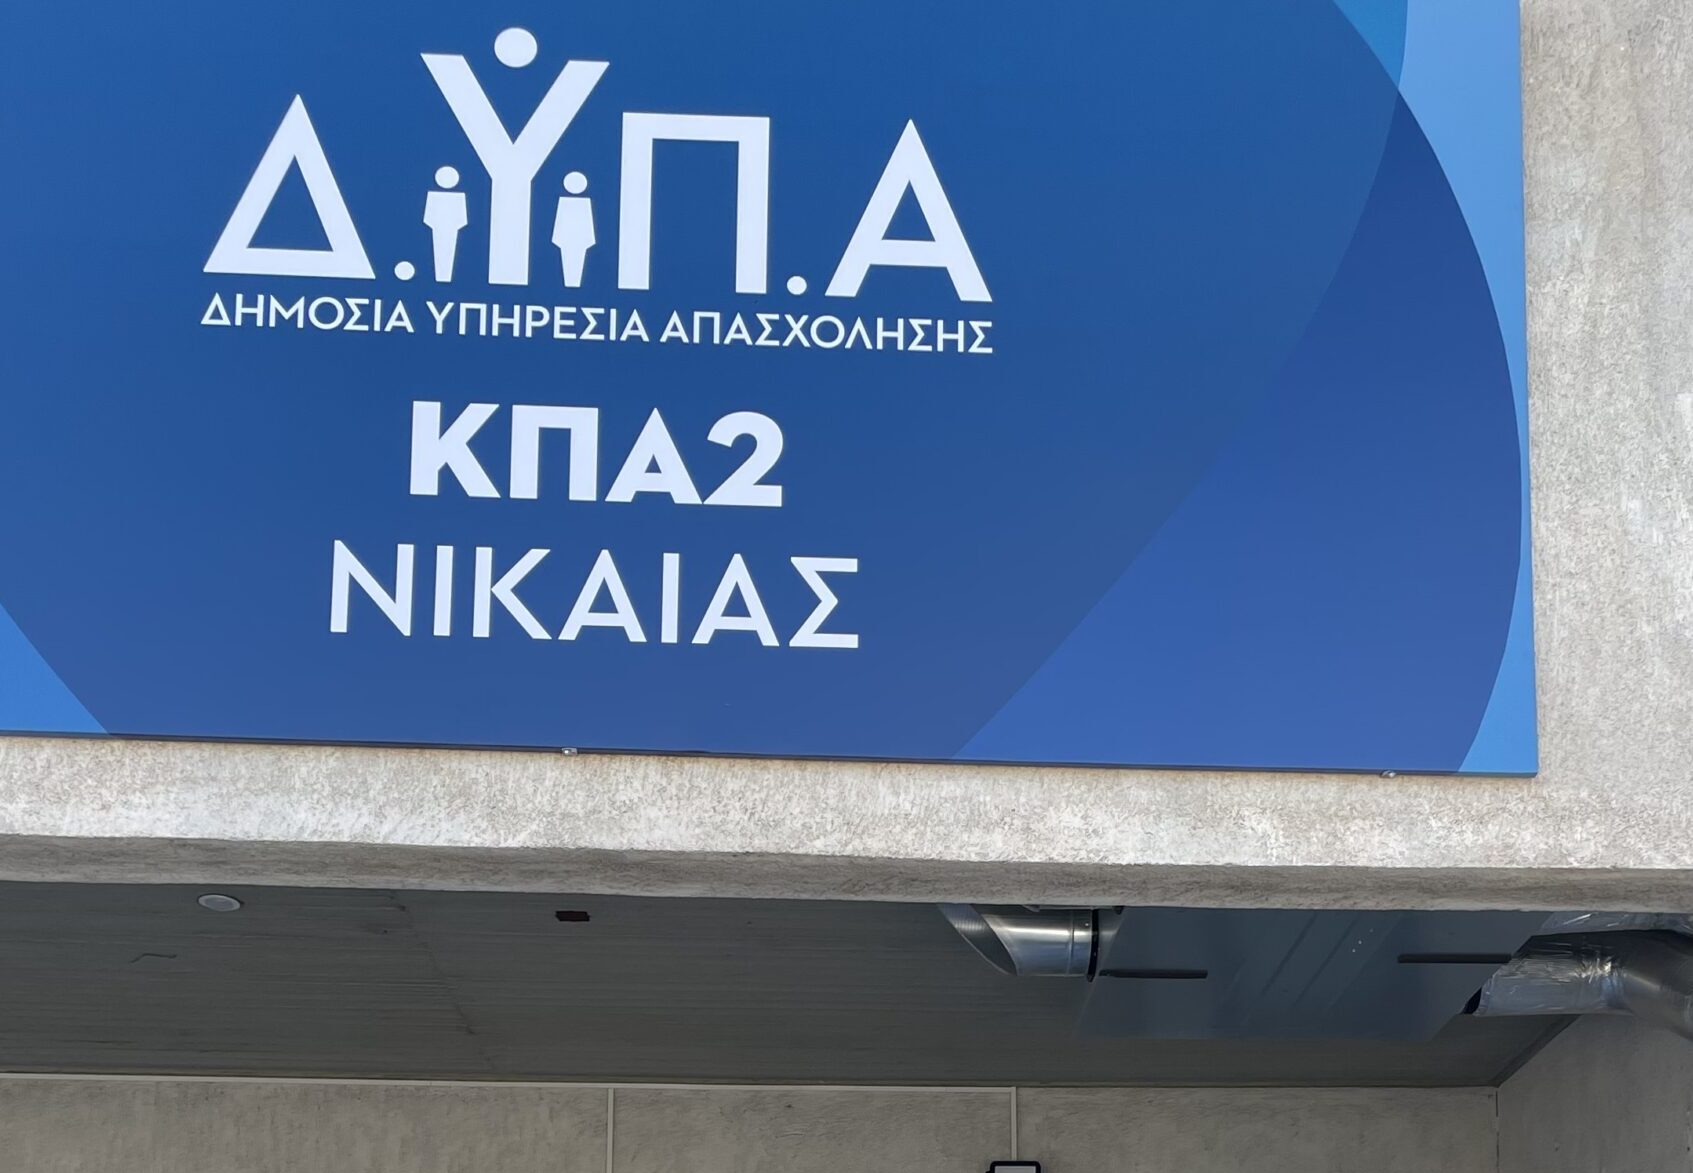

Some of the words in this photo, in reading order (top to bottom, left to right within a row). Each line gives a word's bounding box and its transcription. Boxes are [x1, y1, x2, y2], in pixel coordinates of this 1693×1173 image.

[200, 291, 415, 334] ΔΗΜΟΣΙΑ
[425, 300, 651, 346] ΥΠΗΡΕΣΙΑ
[658, 309, 994, 355] ΑΠΑΣΧΟΛΗΣΗΣ
[409, 399, 785, 508] ΚΠΑ2
[329, 538, 860, 650] ΝΙΚΑΙΑΣ
